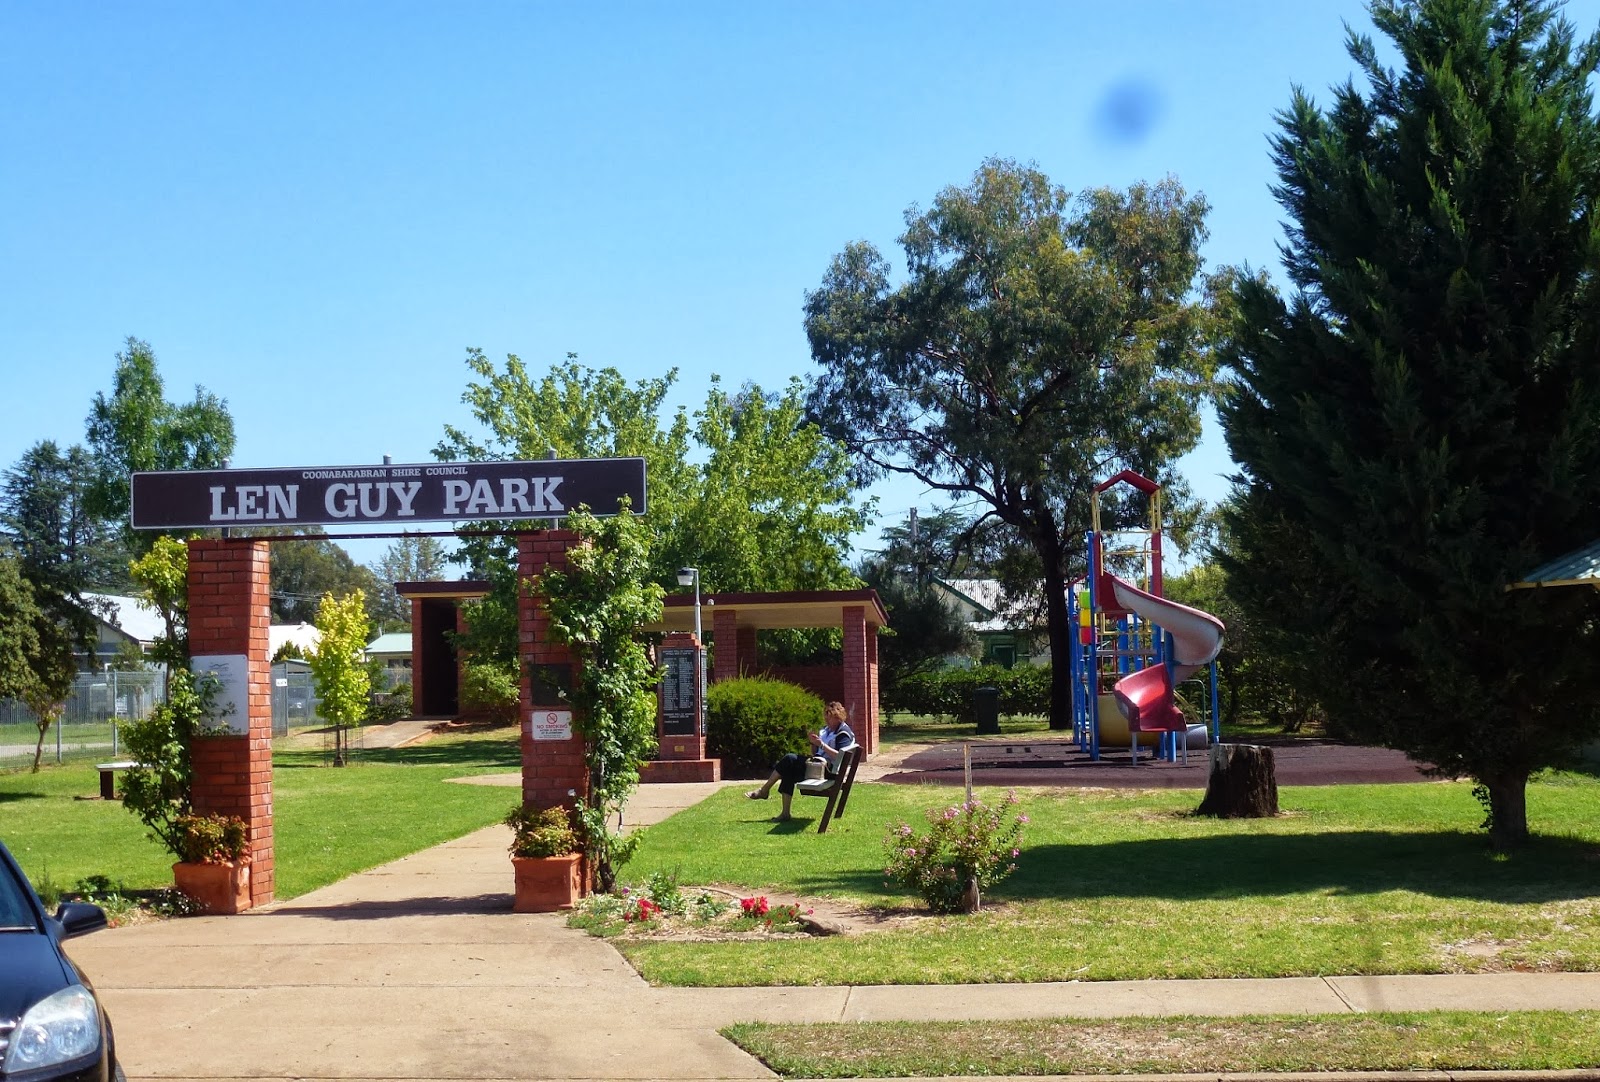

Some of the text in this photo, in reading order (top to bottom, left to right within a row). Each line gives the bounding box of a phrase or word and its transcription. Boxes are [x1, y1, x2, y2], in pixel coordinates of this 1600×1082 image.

[302, 466, 468, 480] COONABARABRAN SHIRE COUNCIL
[209, 476, 564, 521] LEN GUY PARK
